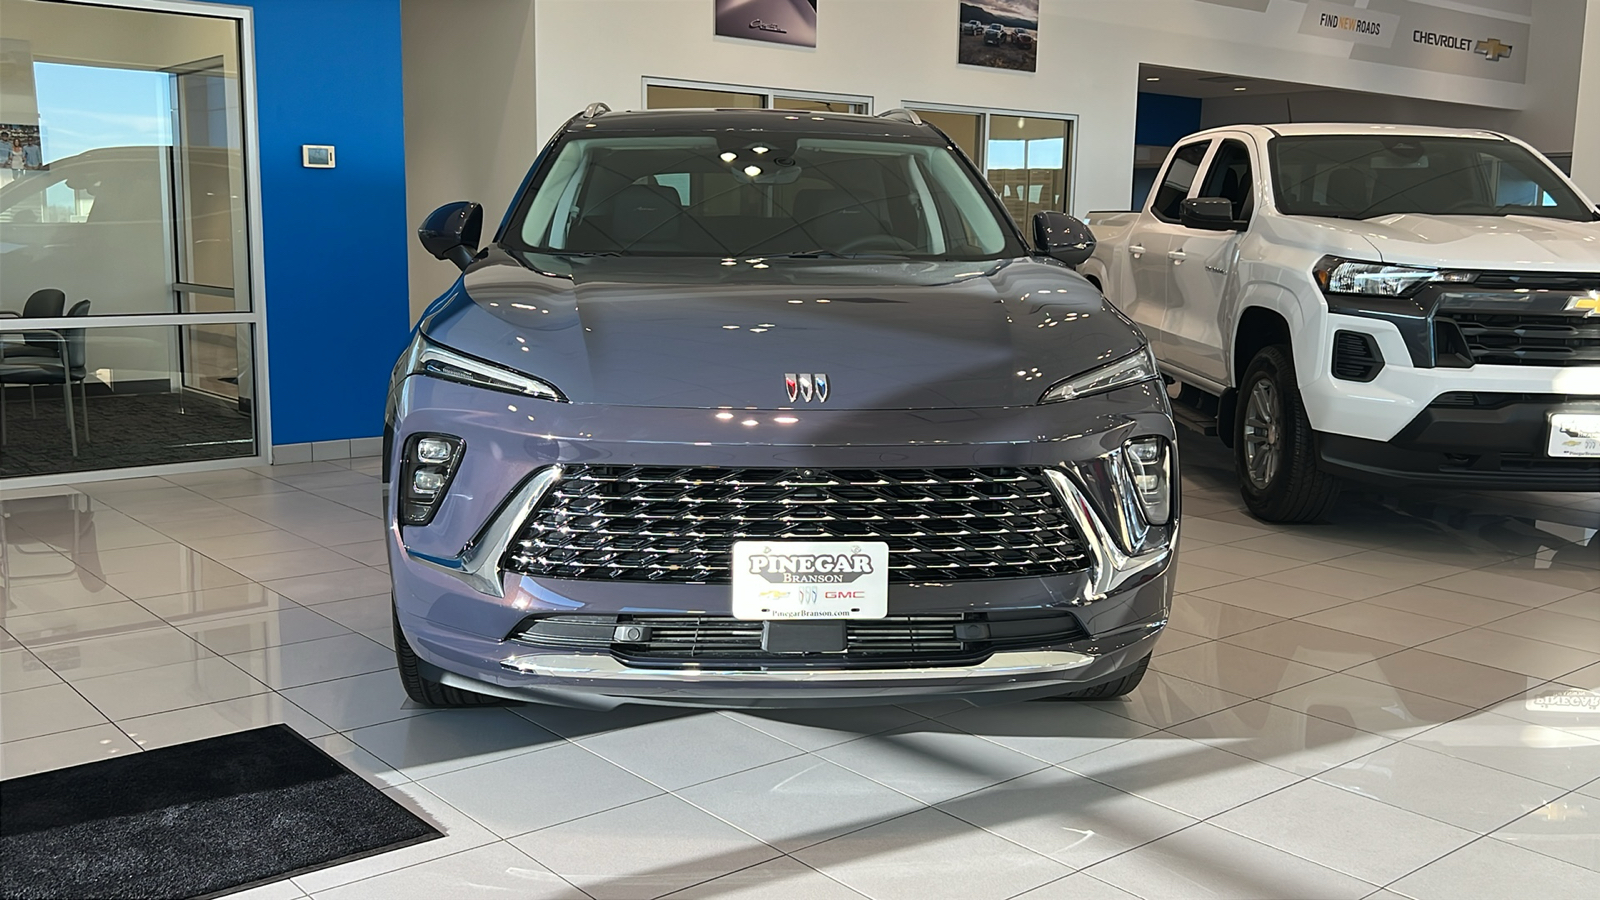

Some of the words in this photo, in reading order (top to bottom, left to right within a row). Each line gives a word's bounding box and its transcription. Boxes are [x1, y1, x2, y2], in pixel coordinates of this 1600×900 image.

[1320, 13, 1338, 28] FIND
[1339, 16, 1357, 31] NEW
[1356, 20, 1380, 35] ROADS
[1413, 30, 1472, 51] CHEVROLET
[749, 554, 874, 574] PINEGAR
[783, 573, 843, 583] BRANSON
[825, 591, 865, 599] GMC
[772, 610, 850, 618] PinegarBranson.com
